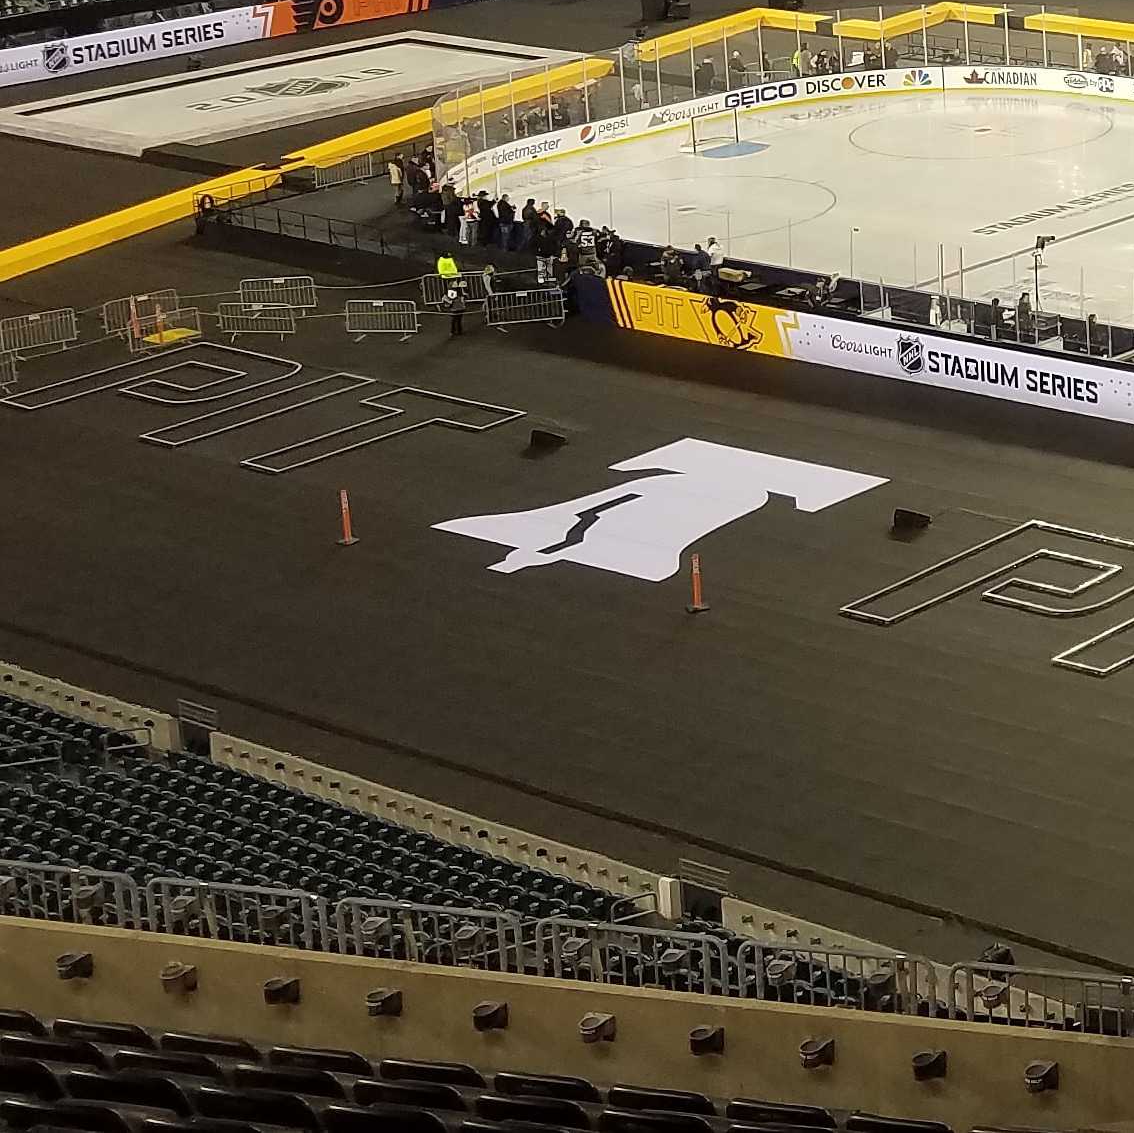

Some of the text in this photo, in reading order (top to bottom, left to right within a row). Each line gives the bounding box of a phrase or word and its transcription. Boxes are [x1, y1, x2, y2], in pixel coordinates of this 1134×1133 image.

[72, 22, 225, 65] STADIUM SERIES
[984, 71, 1038, 86] CANADIAN
[724, 82, 798, 109] GEICO
[598, 117, 630, 136] pepsi
[491, 137, 562, 167] ticketmaster
[973, 204, 1075, 235] STADIUM
[580, 235, 595, 248] 53
[634, 291, 685, 329] PIT
[864, 343, 894, 360] LIGHT
[928, 351, 1099, 404] STADIUM SERIES
